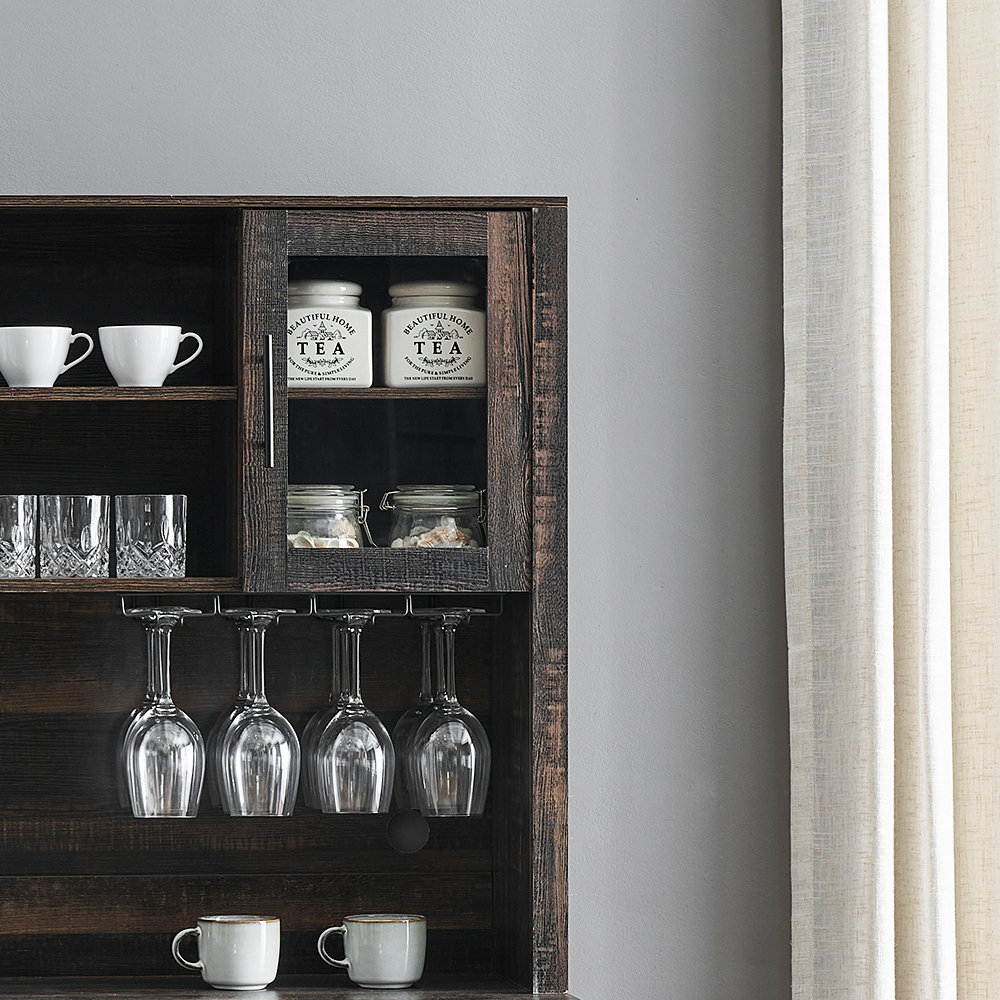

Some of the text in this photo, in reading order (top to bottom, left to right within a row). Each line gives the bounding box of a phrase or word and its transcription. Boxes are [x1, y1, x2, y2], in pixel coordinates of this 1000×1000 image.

[287, 313, 356, 336] BEAUTIFUL HOME
[403, 313, 474, 335] BEAUTIFUL HOME
[297, 341, 345, 355] TEA
[414, 341, 463, 355] TEA
